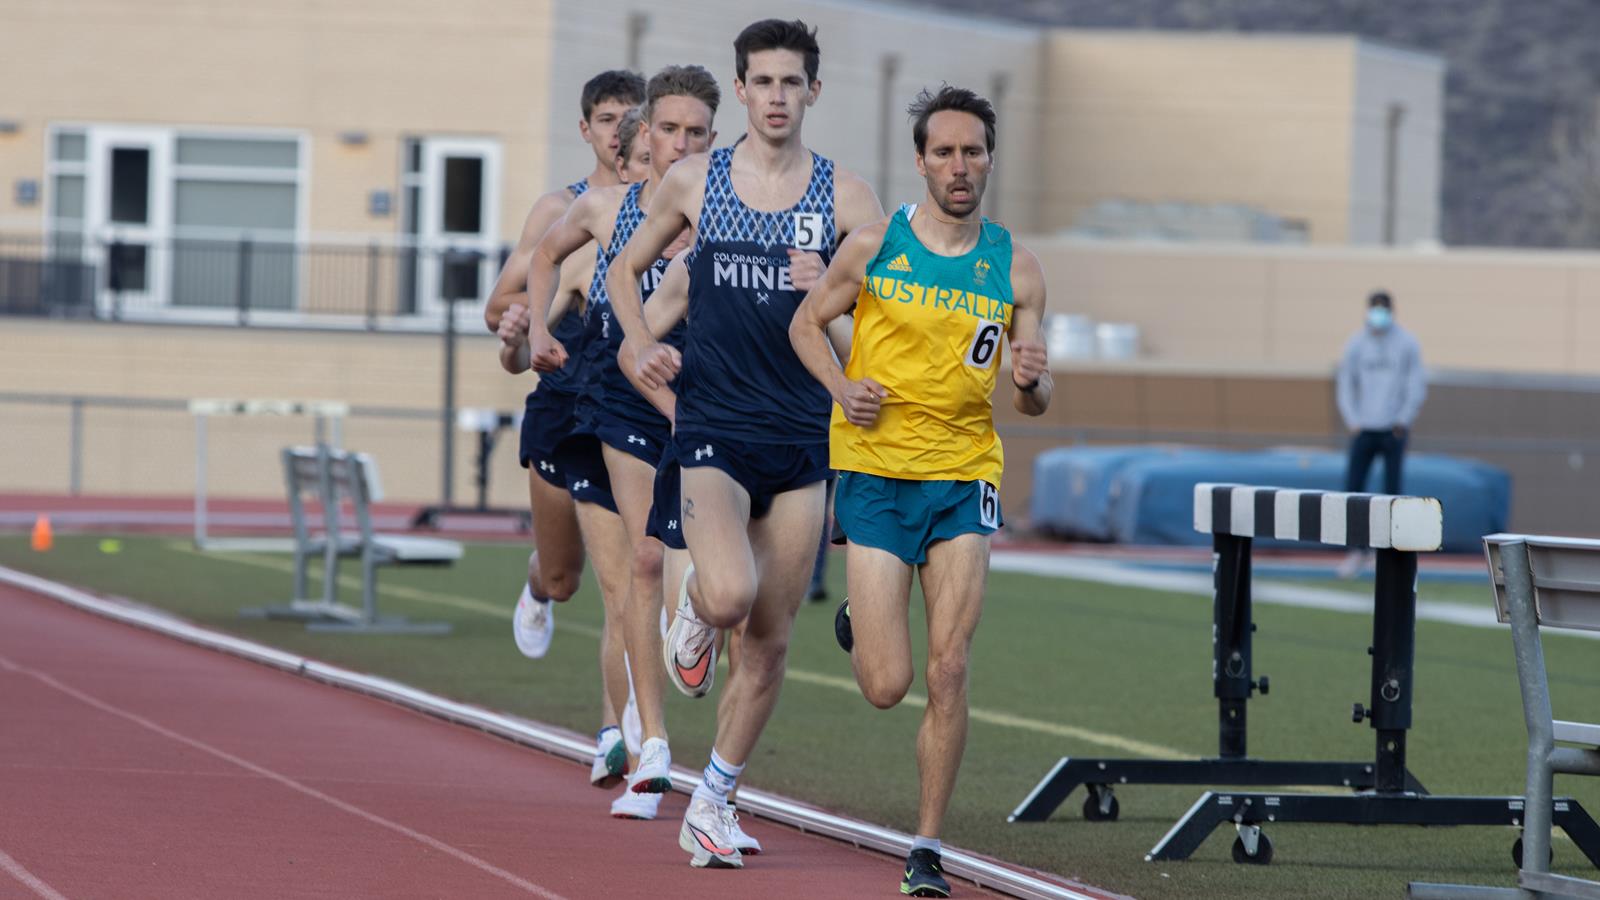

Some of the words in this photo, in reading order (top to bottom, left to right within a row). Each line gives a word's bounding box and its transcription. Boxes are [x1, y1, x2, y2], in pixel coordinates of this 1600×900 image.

[798, 216, 814, 246] 5
[865, 276, 1006, 321] AUSTRALIA
[971, 325, 999, 365] 6
[982, 482, 995, 523] 6
